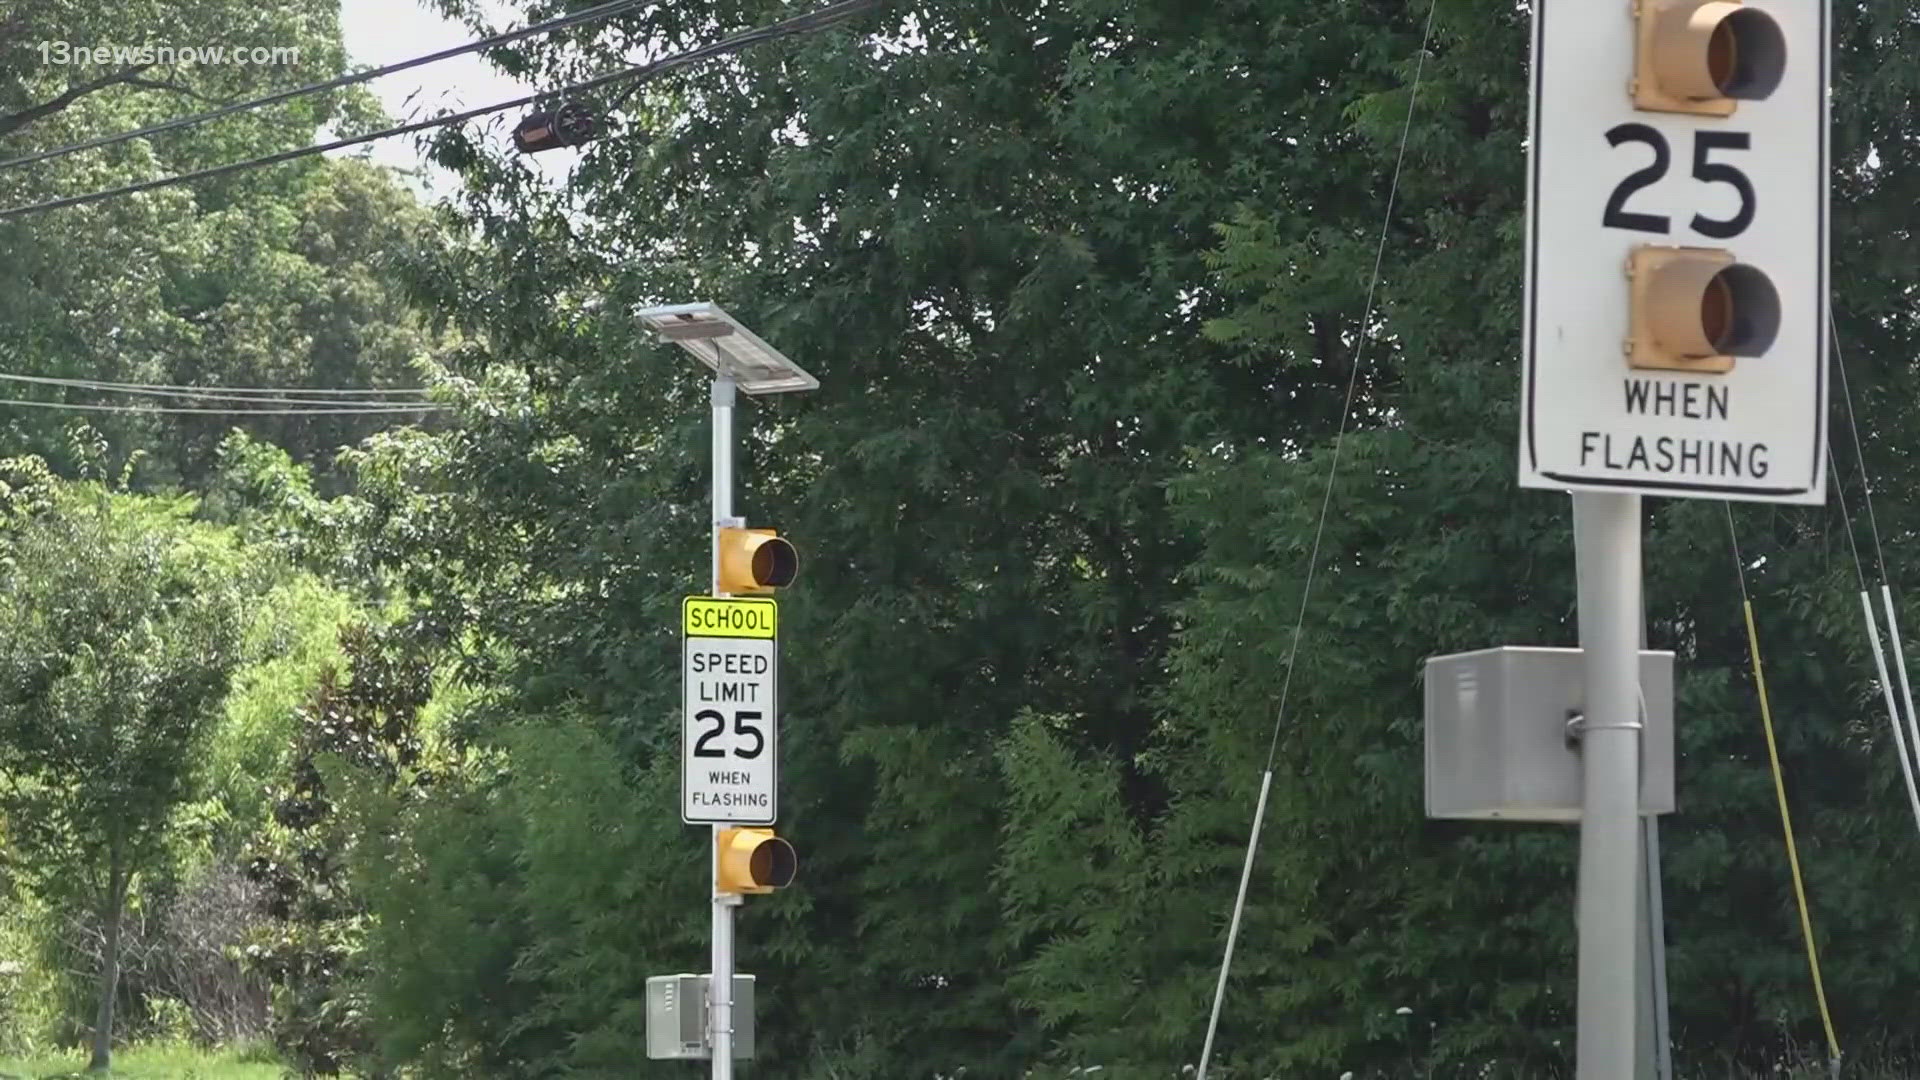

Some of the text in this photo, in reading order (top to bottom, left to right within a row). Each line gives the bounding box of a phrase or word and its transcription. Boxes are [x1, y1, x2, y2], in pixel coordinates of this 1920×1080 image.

[1602, 122, 1757, 239] 25
[1623, 379, 1729, 421] WHEN
[1580, 432, 1769, 479] FLASHING
[691, 607, 770, 630] SCHOOL
[692, 653, 768, 674] SPEED
[700, 681, 759, 703] LIMIT
[694, 709, 765, 760] 25
[708, 771, 750, 785] WHEN
[692, 791, 768, 807] FLASHING
